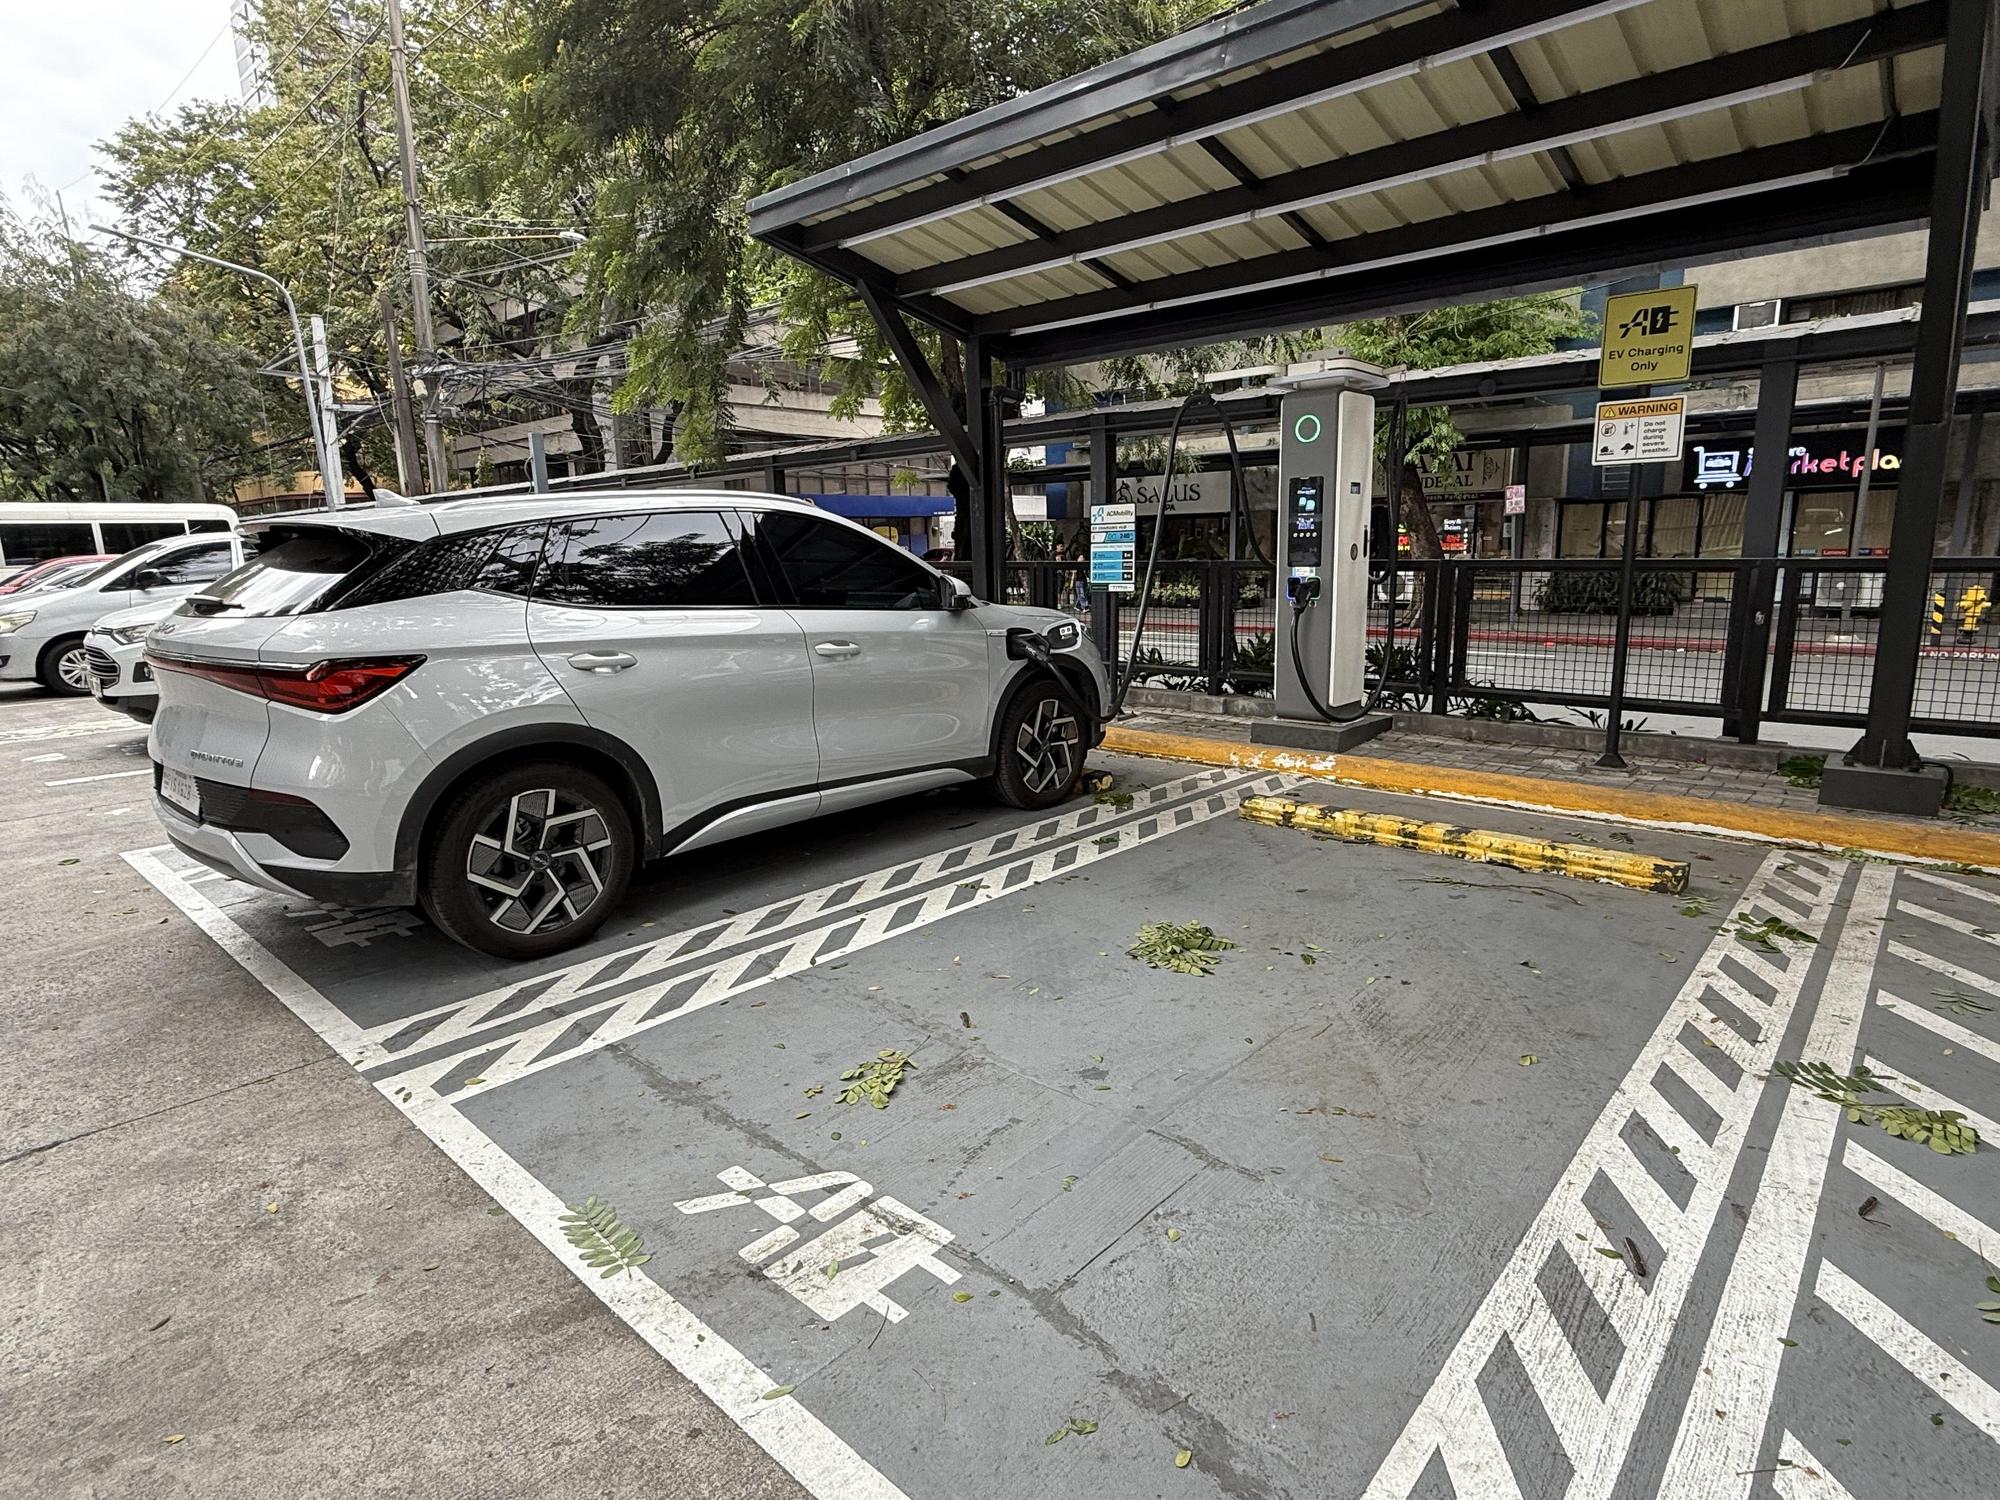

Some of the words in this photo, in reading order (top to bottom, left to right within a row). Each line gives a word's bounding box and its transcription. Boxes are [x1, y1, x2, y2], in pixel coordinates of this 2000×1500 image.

[1609, 350, 1625, 360] EV
[1628, 344, 1684, 357] Charging
[1630, 361, 1658, 371] Only
[1618, 402, 1678, 415] WARNING
[1953, 652, 2000, 660] PARKIN
